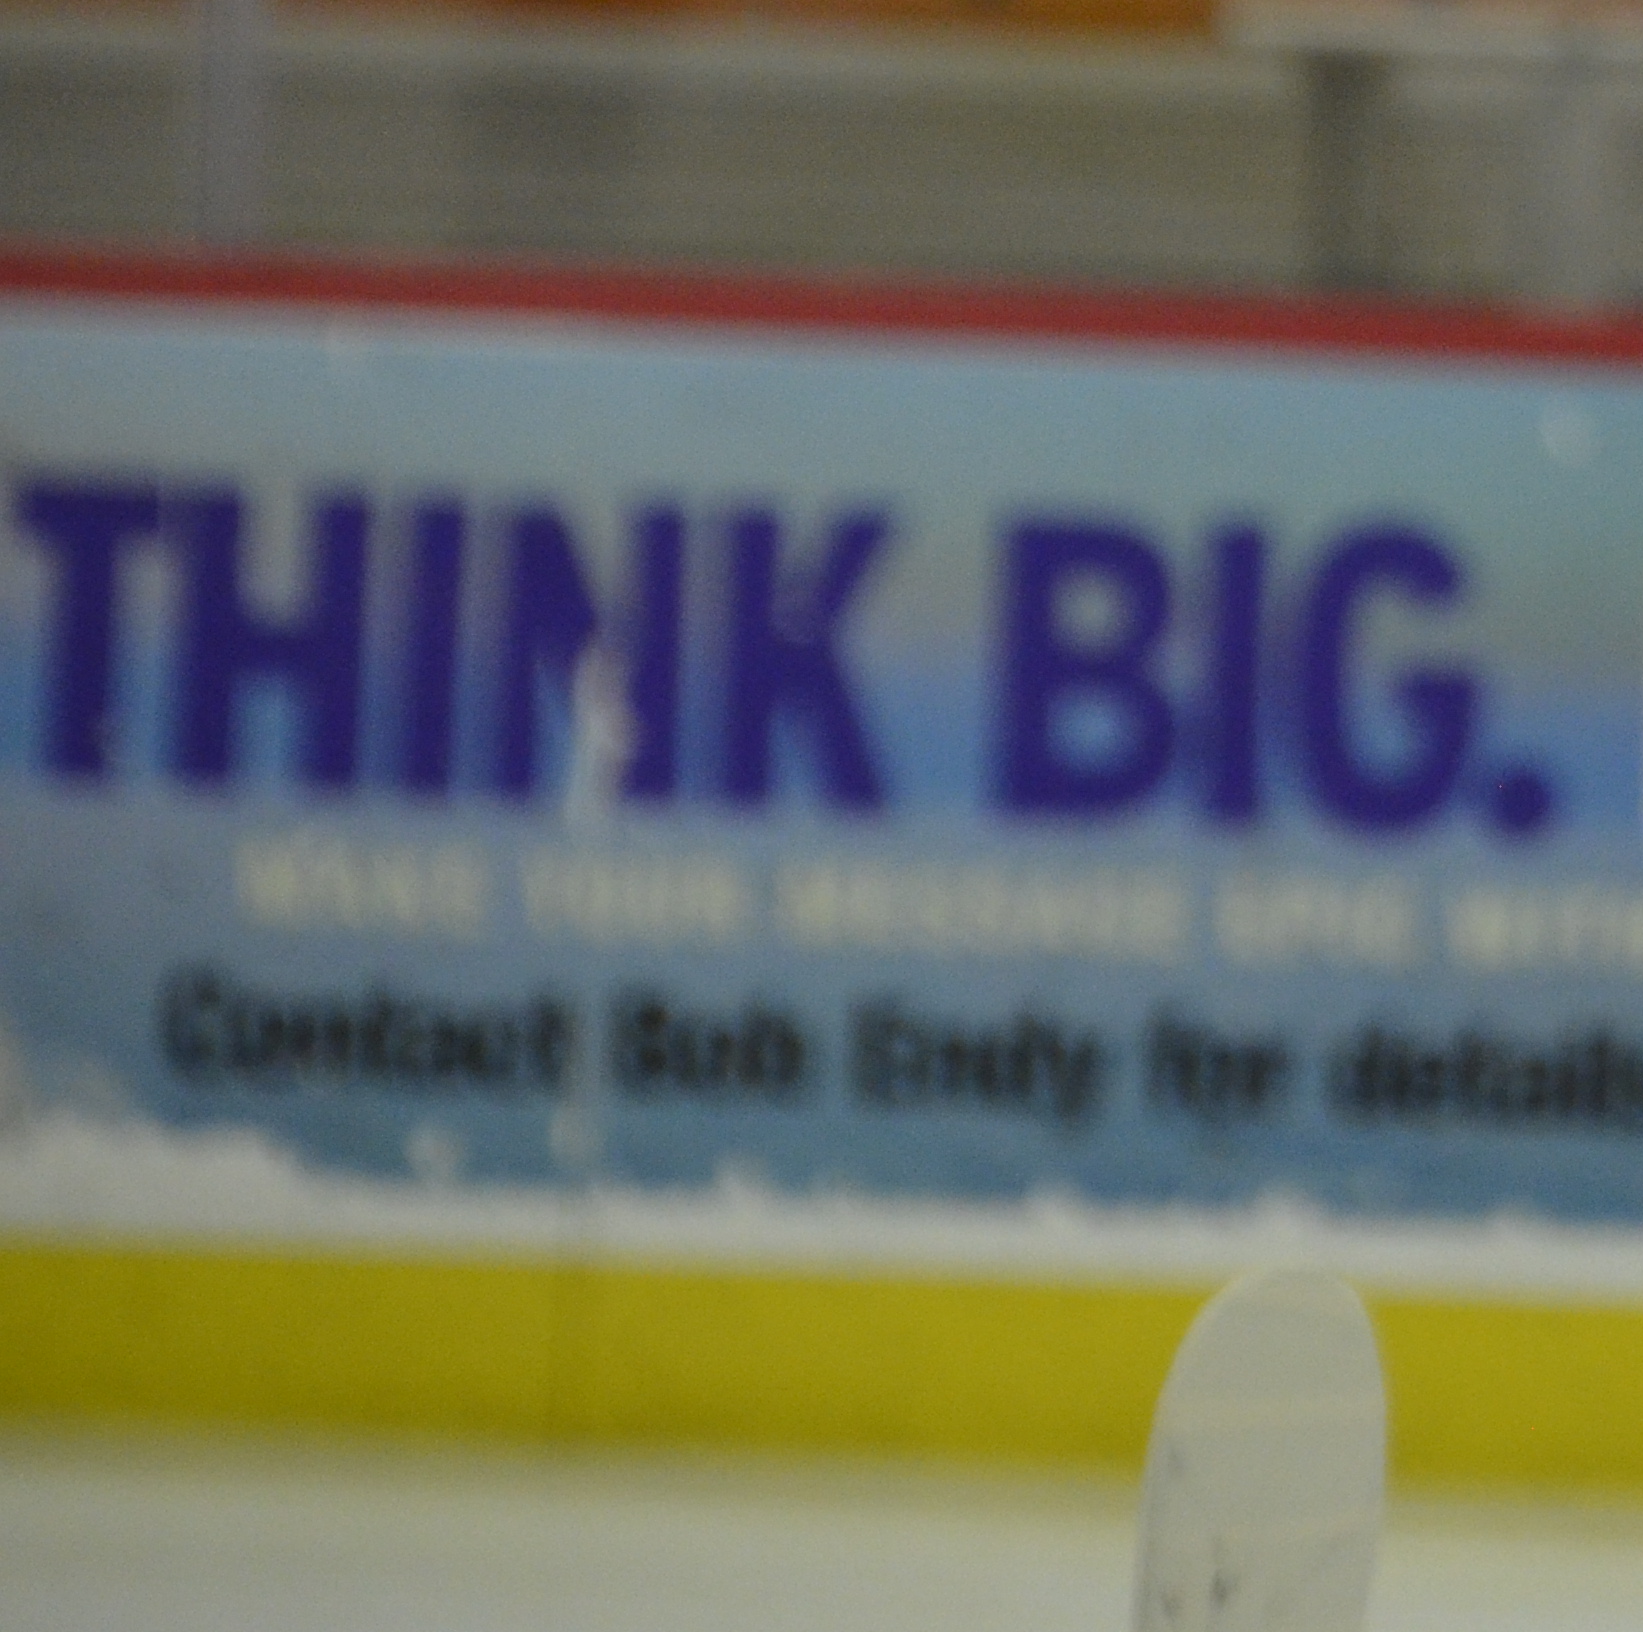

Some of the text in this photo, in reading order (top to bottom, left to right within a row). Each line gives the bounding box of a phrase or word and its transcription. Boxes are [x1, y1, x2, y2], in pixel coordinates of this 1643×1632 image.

[16, 473, 895, 813] THINK
[988, 508, 1556, 844] BIG.
[154, 960, 575, 1090] Contact
